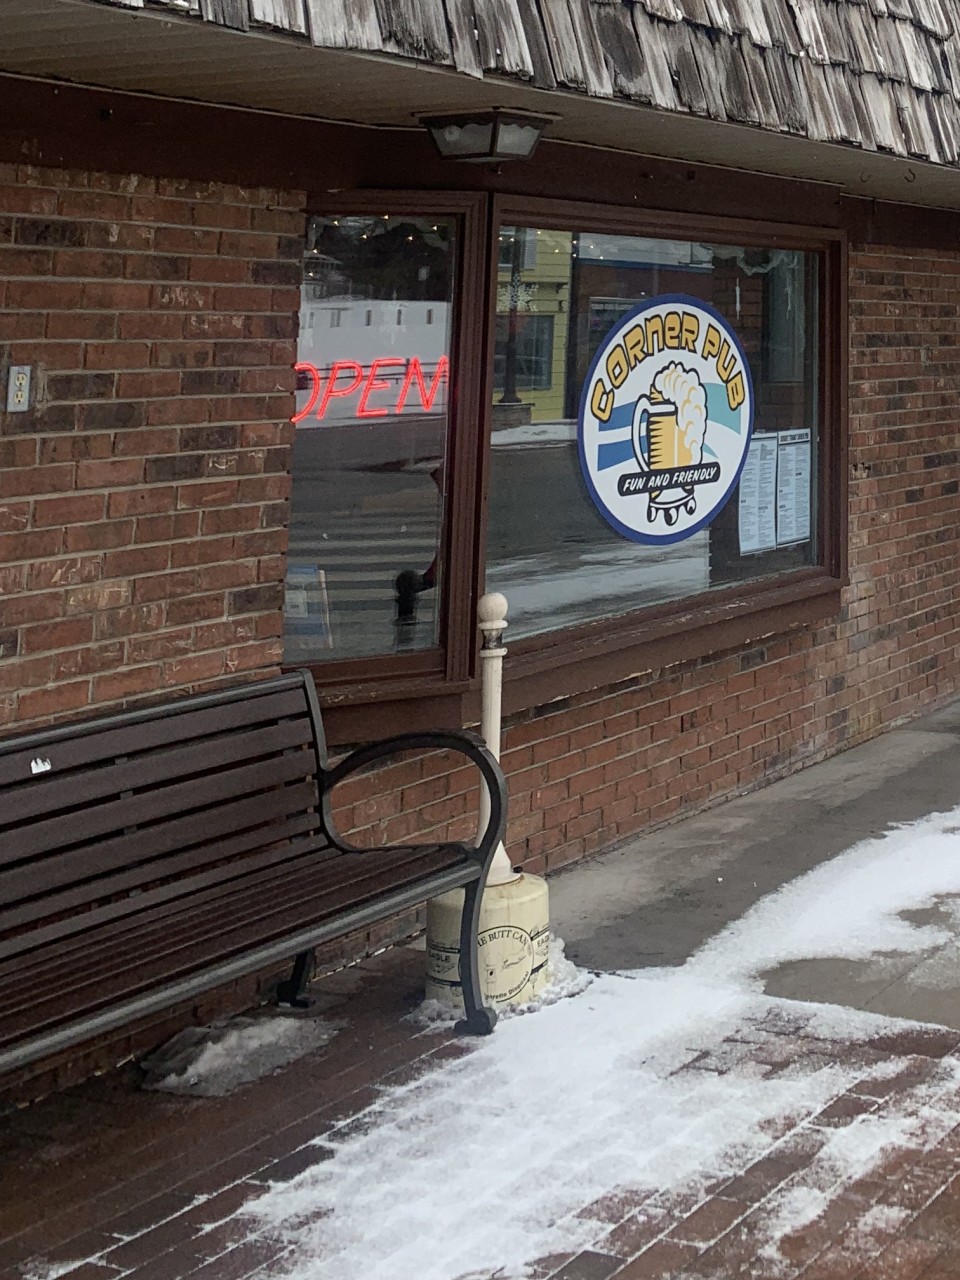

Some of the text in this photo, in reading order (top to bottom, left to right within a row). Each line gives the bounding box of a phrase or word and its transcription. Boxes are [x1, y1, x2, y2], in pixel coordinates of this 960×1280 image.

[701, 323, 746, 411] PUB
[623, 466, 718, 492] FUN AND FRIENDLY
[488, 929, 512, 942] BUTT
[512, 931, 529, 946] CAN
